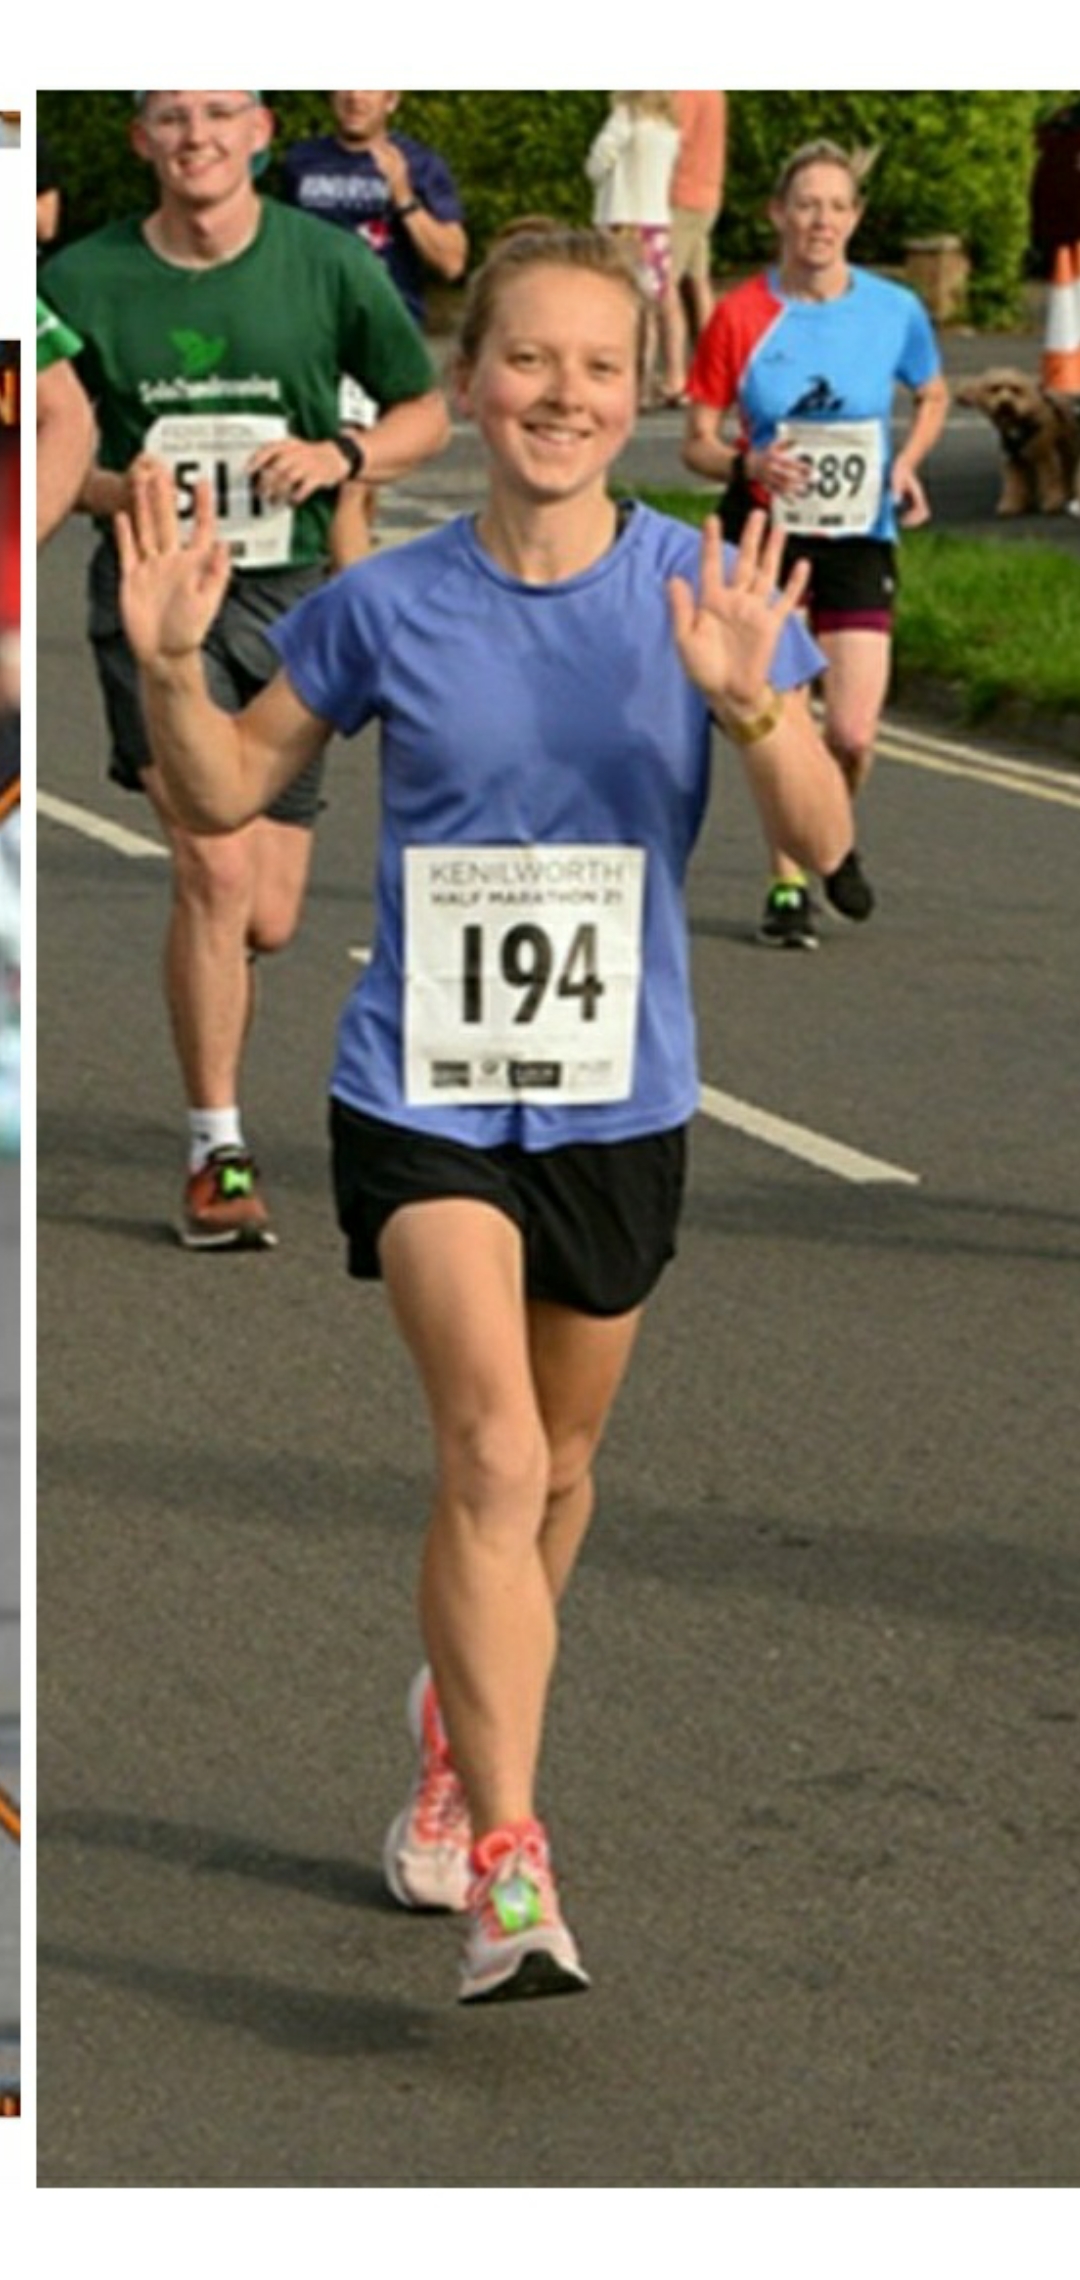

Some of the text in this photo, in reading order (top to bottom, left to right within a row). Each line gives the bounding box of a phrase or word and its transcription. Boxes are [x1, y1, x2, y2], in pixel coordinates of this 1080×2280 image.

[429, 861, 624, 884] KENILWORTH
[430, 891, 481, 907] HALF
[488, 890, 598, 906] MARATHON
[461, 922, 606, 1025] 194
